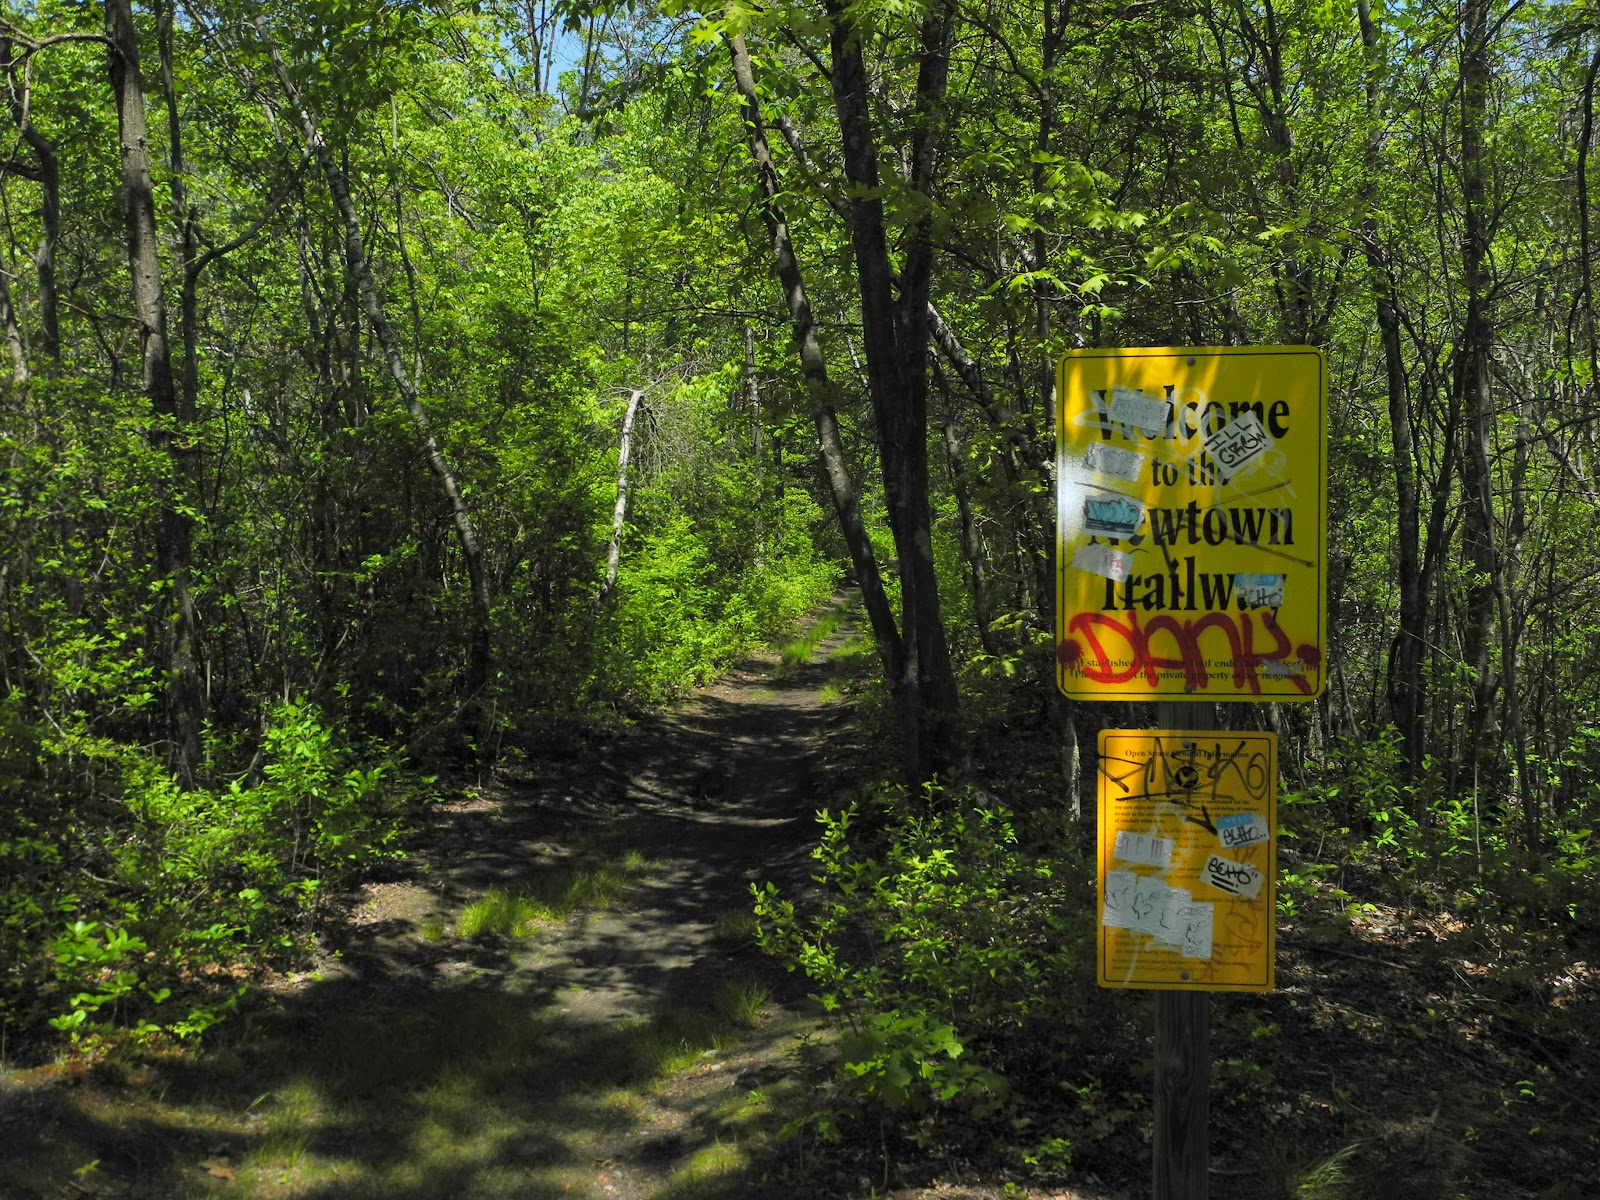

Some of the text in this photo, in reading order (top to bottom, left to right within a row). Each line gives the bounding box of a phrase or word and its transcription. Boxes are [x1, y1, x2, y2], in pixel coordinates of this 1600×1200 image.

[1092, 384, 1290, 440] Wlcome
[1151, 457, 1178, 487] to
[1088, 500, 1295, 547] wtown
[1095, 556, 1288, 627] Trailw
[1081, 658, 1136, 667] Estaished
[1191, 671, 1229, 682] prperty
[1125, 749, 1146, 758] Open
[1171, 750, 1202, 758] Geneal
[1203, 750, 1250, 759] Infrmtion
